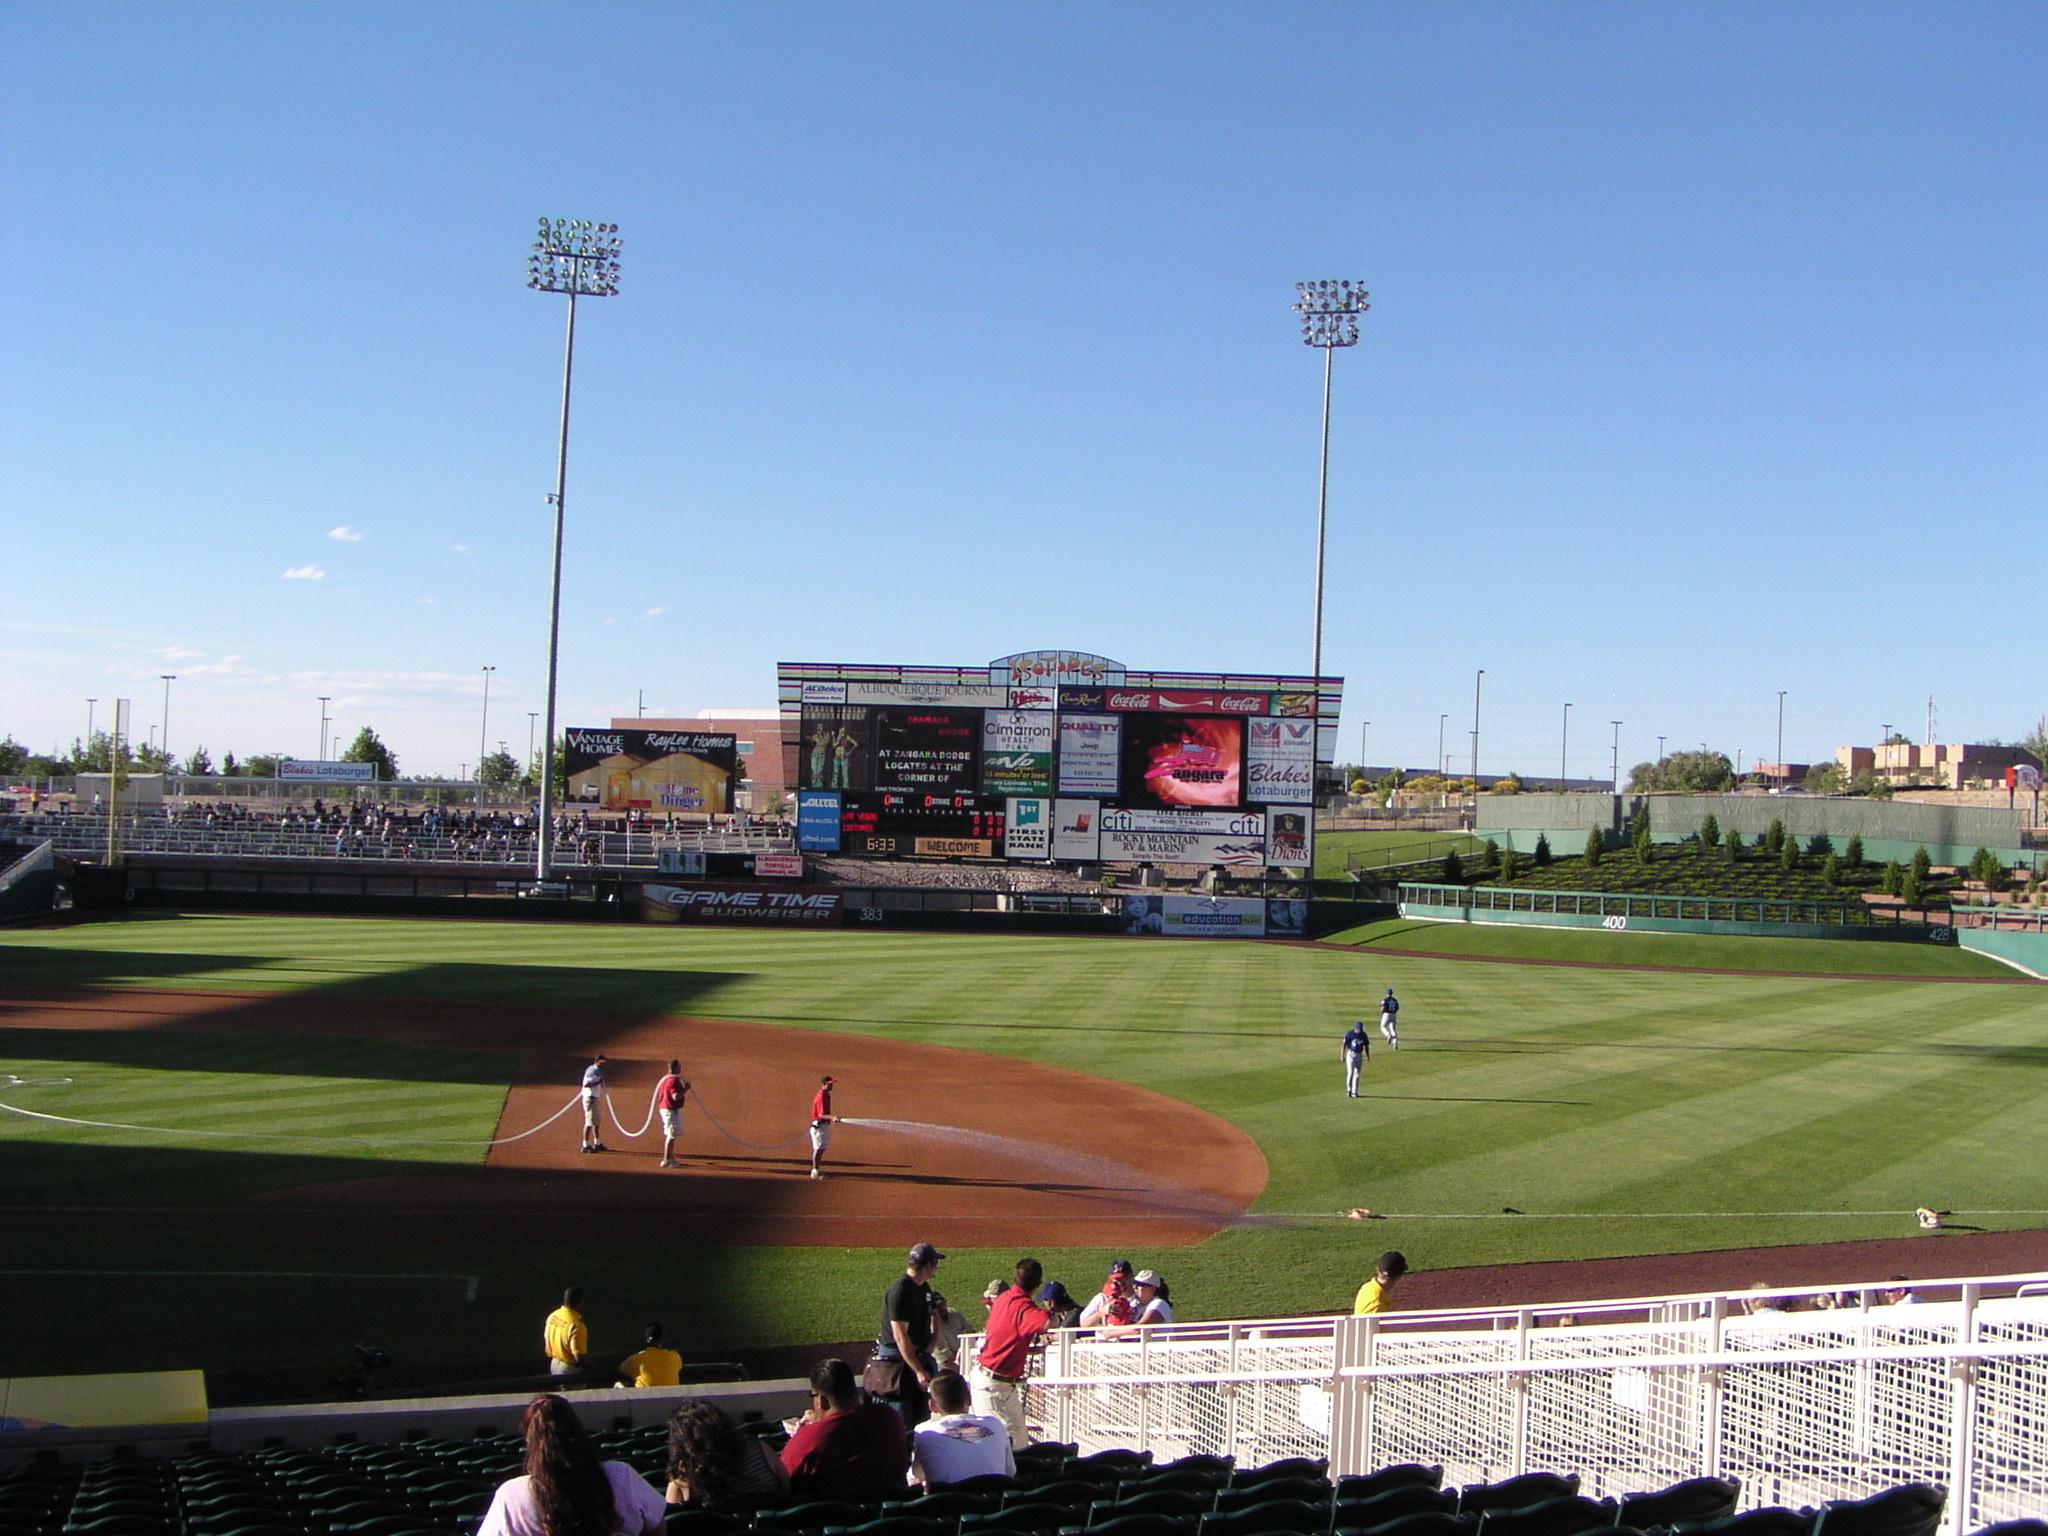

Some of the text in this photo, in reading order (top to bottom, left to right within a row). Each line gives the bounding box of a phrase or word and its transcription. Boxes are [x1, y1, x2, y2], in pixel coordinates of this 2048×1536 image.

[859, 683, 997, 698] ALBUQUERQUE JOURNAL
[985, 723, 1050, 737] Cimarron
[1058, 722, 1120, 731] QUALITY
[568, 729, 625, 748] VANTAGE
[692, 735, 732, 748] Homes
[580, 744, 625, 754] HOMES
[880, 750, 891, 758] AT
[939, 751, 971, 760] DODGE
[317, 766, 370, 778] Lotaburger
[885, 762, 927, 770] LOCATED
[945, 763, 963, 771] THE
[898, 774, 950, 783] CORNER OF
[1248, 784, 1311, 799] Lotaburger
[1102, 812, 1132, 830] citi
[1229, 818, 1260, 834] citi
[867, 838, 896, 851] 6:33
[1112, 832, 1199, 845] ROCKY MOUNTAIN
[927, 841, 980, 853] WELCOME
[1148, 843, 1187, 853] MARINE
[668, 890, 840, 908] GAME TIME
[701, 907, 830, 919] BUDWEISER
[860, 908, 883, 922] 383
[1184, 913, 1241, 924] education
[1602, 915, 1626, 929] 400
[1929, 928, 1951, 941] 428
